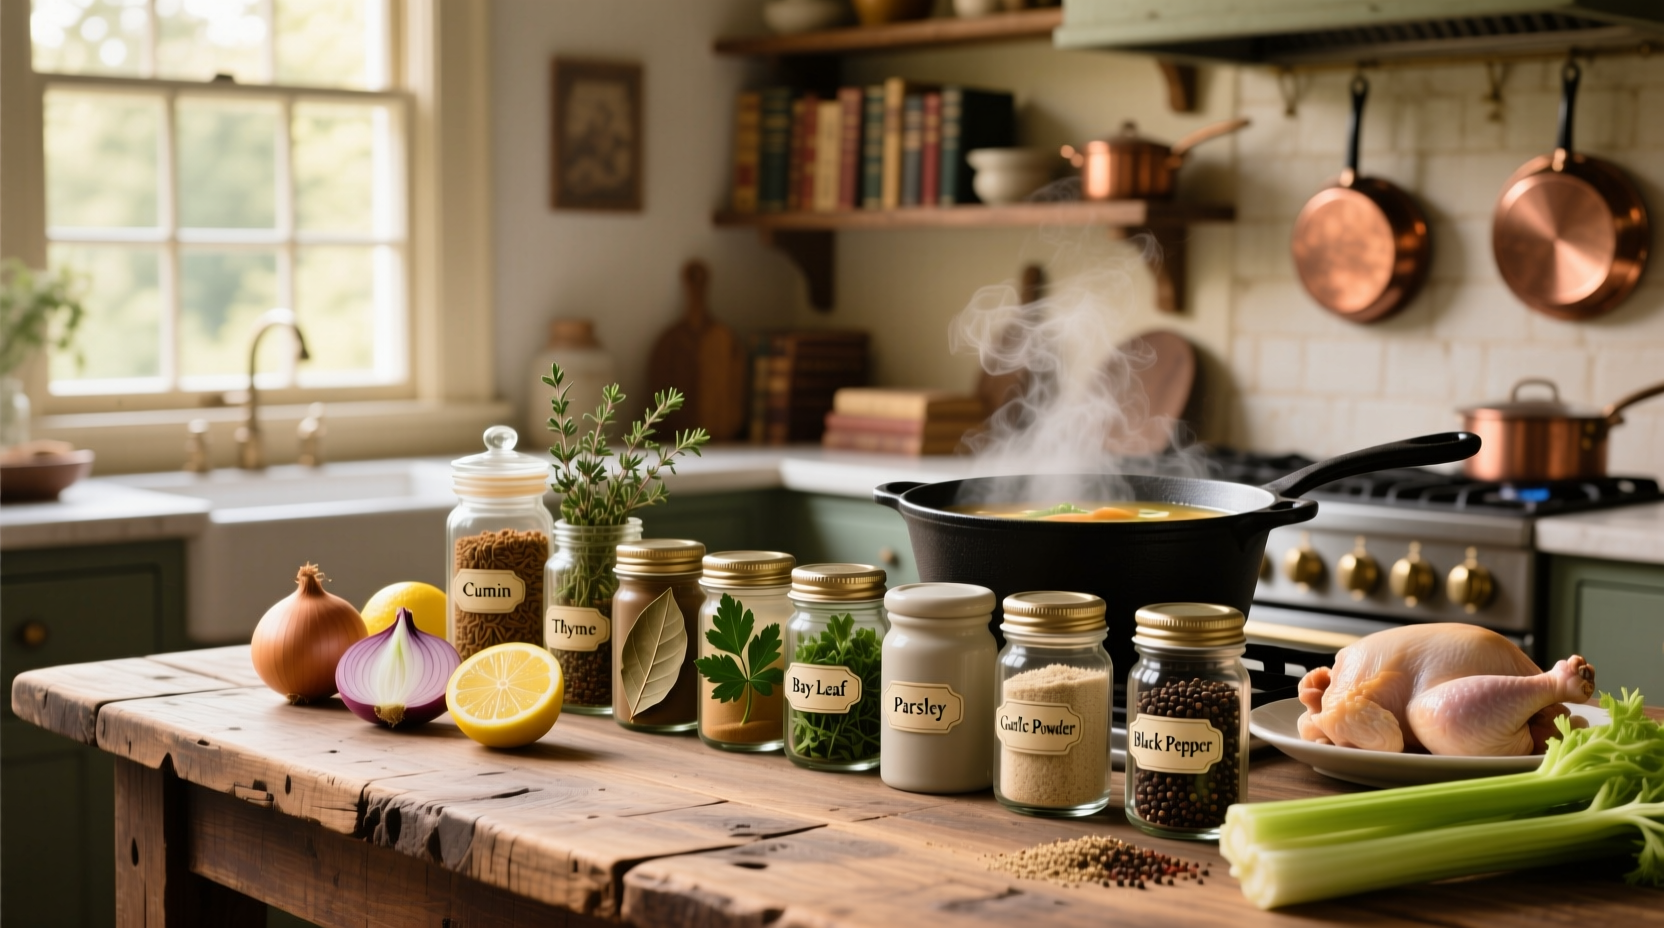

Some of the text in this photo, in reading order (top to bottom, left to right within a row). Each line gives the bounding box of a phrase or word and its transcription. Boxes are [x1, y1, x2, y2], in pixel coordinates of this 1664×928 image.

[462, 581, 512, 598] Cumin
[551, 618, 597, 639] Thyme
[792, 676, 848, 698] Bay Leaf
[893, 696, 947, 721] Parsley
[1031, 718, 1076, 736] Powder
[1133, 730, 1213, 758] Black Pepper
